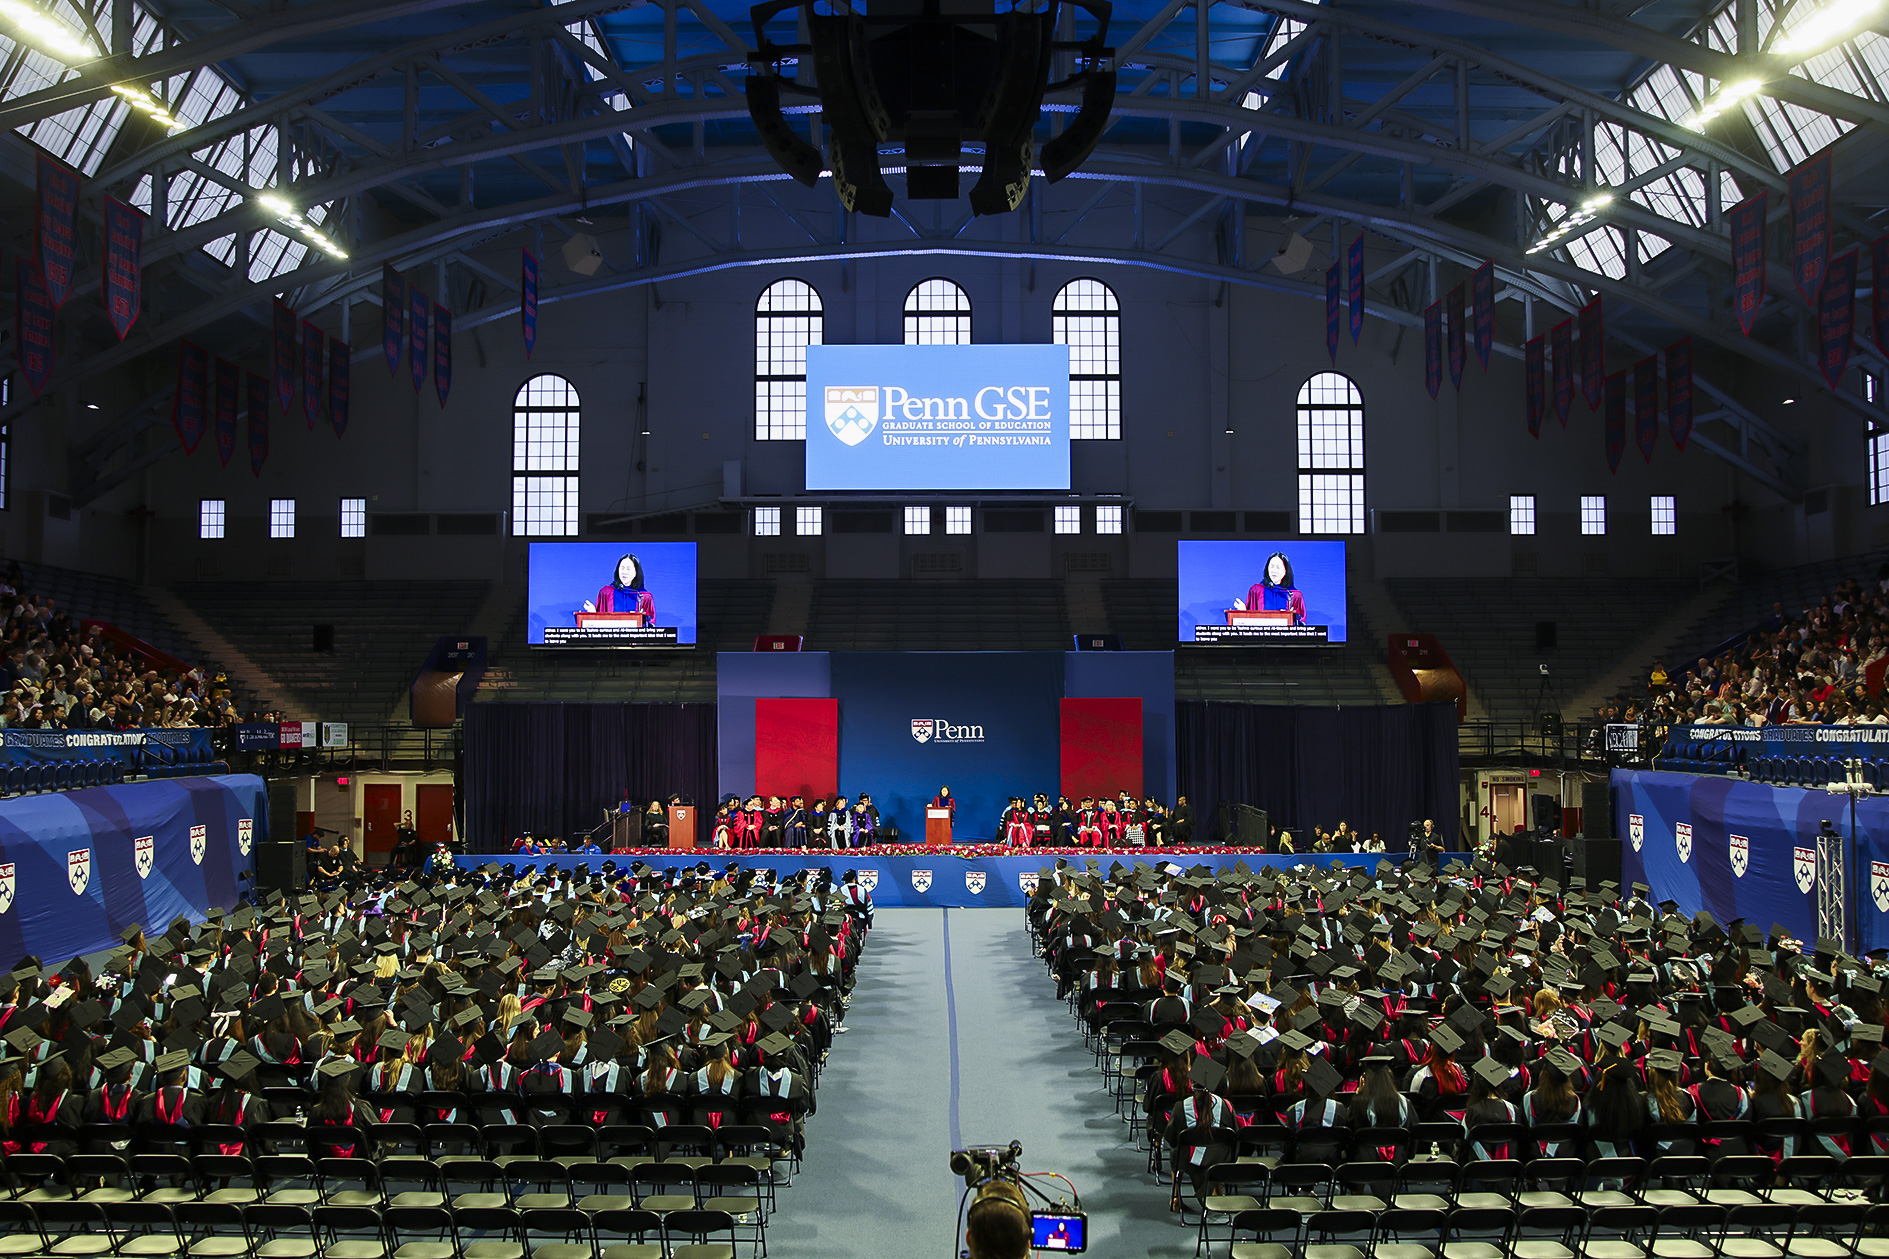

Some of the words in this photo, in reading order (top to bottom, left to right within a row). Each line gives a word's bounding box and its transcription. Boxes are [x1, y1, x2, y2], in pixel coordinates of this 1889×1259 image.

[47, 261, 67, 286] 1975
[883, 386, 971, 420] Penn
[975, 386, 1051, 420] GSE
[883, 421, 933, 429] GRADUATE
[937, 421, 975, 429] SCHOOL
[979, 421, 992, 429] OF
[995, 421, 1051, 429] EDUCATION
[883, 435, 949, 445] UNIVERSITY
[953, 434, 966, 447] of
[969, 435, 1051, 445] PENNSYLVANIA
[935, 719, 985, 739] Penn
[1762, 729, 1814, 742] GRADUATES
[5, 733, 65, 747] GRADUATES
[147, 731, 190, 744] GRADUATES
[286, 733, 301, 744] QUAKERS
[404, 810, 412, 821] 3
[1480, 806, 1489, 818] 4
